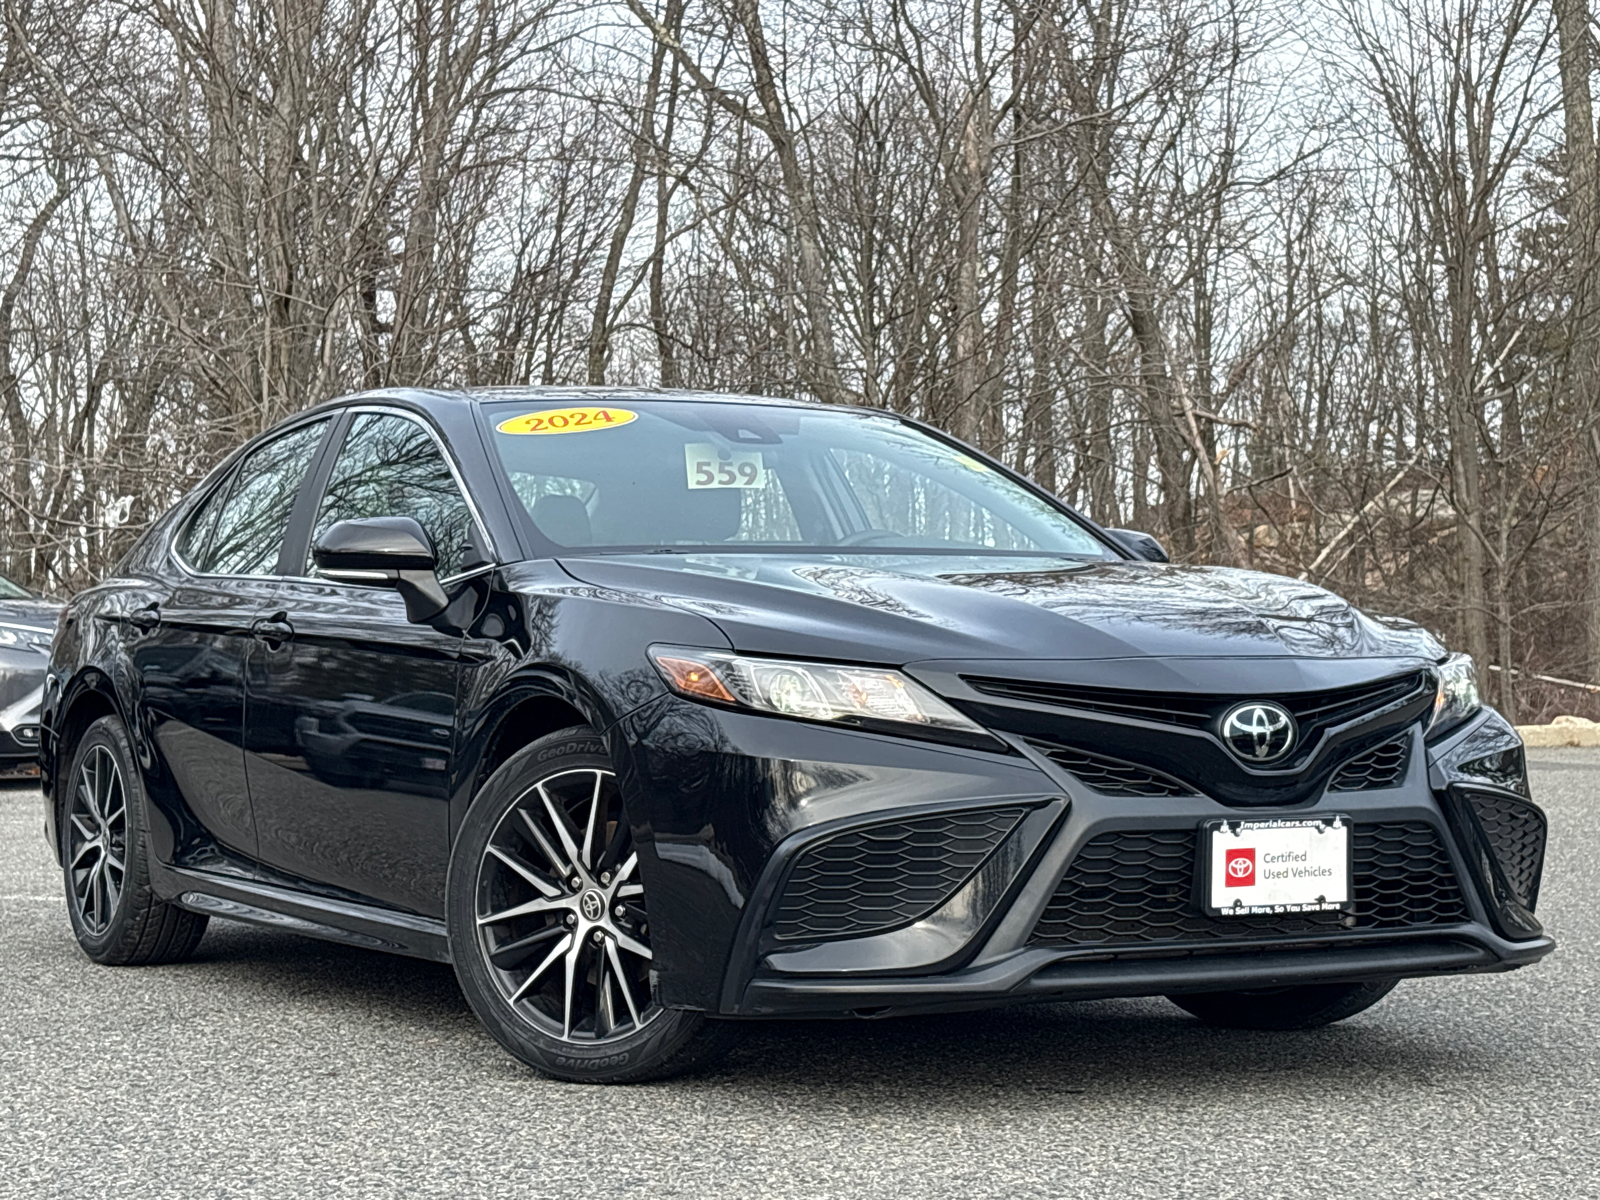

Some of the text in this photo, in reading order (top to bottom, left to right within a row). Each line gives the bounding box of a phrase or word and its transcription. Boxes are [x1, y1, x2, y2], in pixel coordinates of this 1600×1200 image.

[525, 410, 616, 432] 2024
[695, 461, 758, 486] 559
[537, 741, 607, 761] GeoDrive
[1240, 819, 1322, 831] Imperialcars.com
[1263, 851, 1307, 863] Certified
[1263, 866, 1332, 879] Used Vehicles
[1221, 907, 1234, 915] We
[1251, 906, 1273, 914] More,
[1274, 905, 1284, 913] So
[1286, 904, 1300, 912] You
[1302, 903, 1320, 912] Save
[1321, 902, 1340, 910] More
